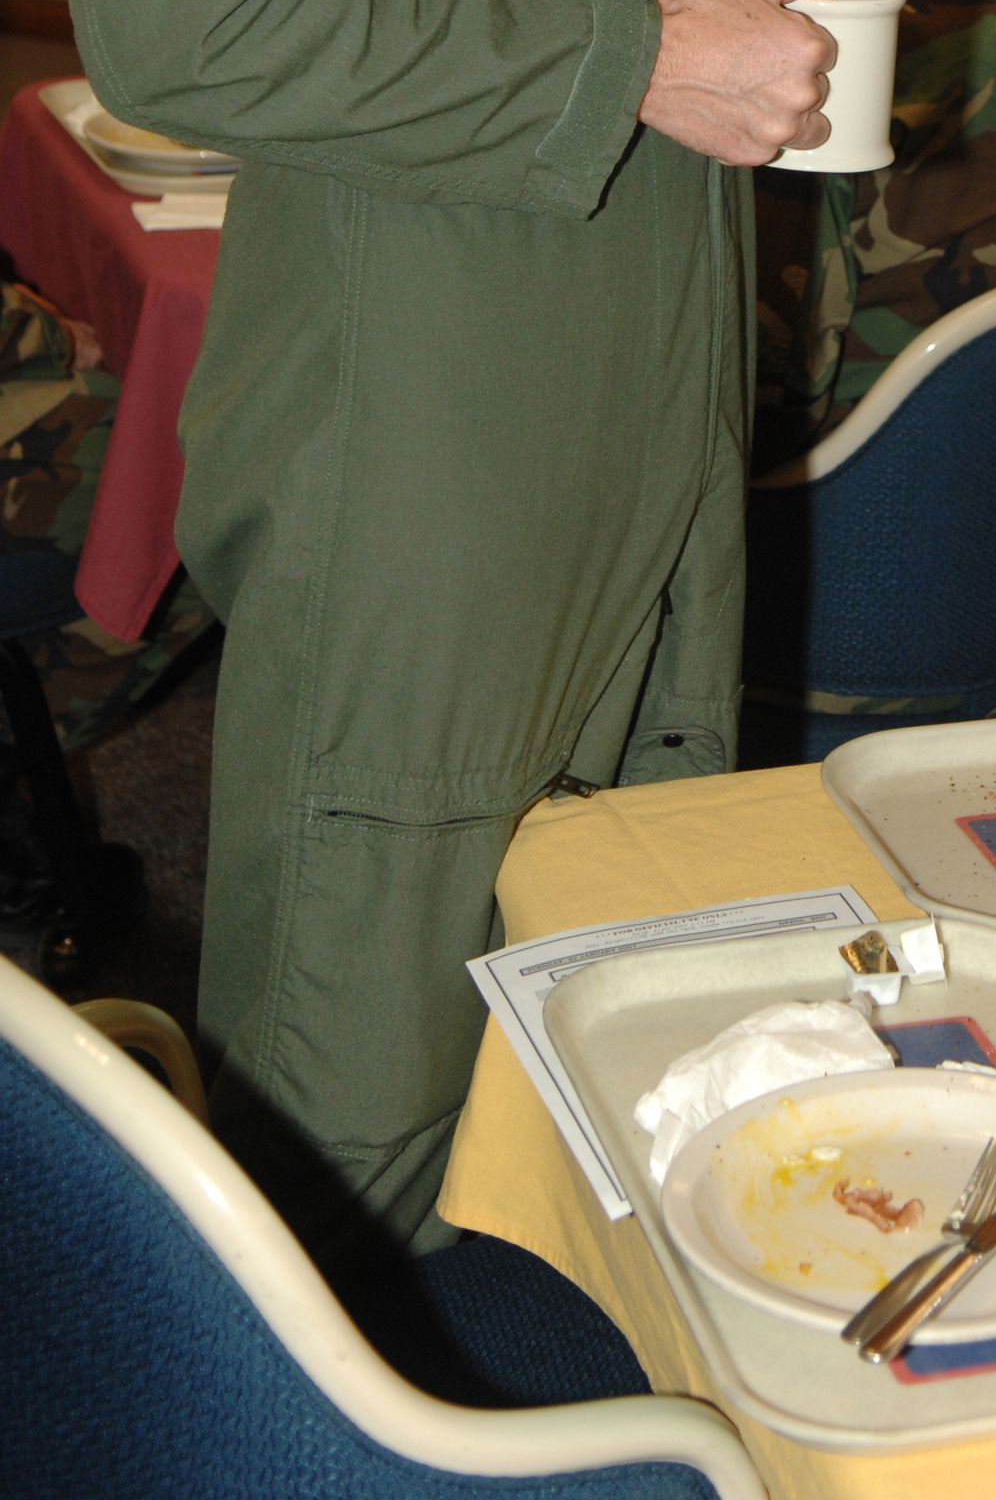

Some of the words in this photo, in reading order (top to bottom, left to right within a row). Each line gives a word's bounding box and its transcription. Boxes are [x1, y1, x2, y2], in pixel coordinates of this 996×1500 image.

[613, 928, 633, 936] FOR
[634, 921, 681, 933] OFFICIAL
[702, 912, 728, 920] ONLY
[577, 948, 616, 960] JANUARY
